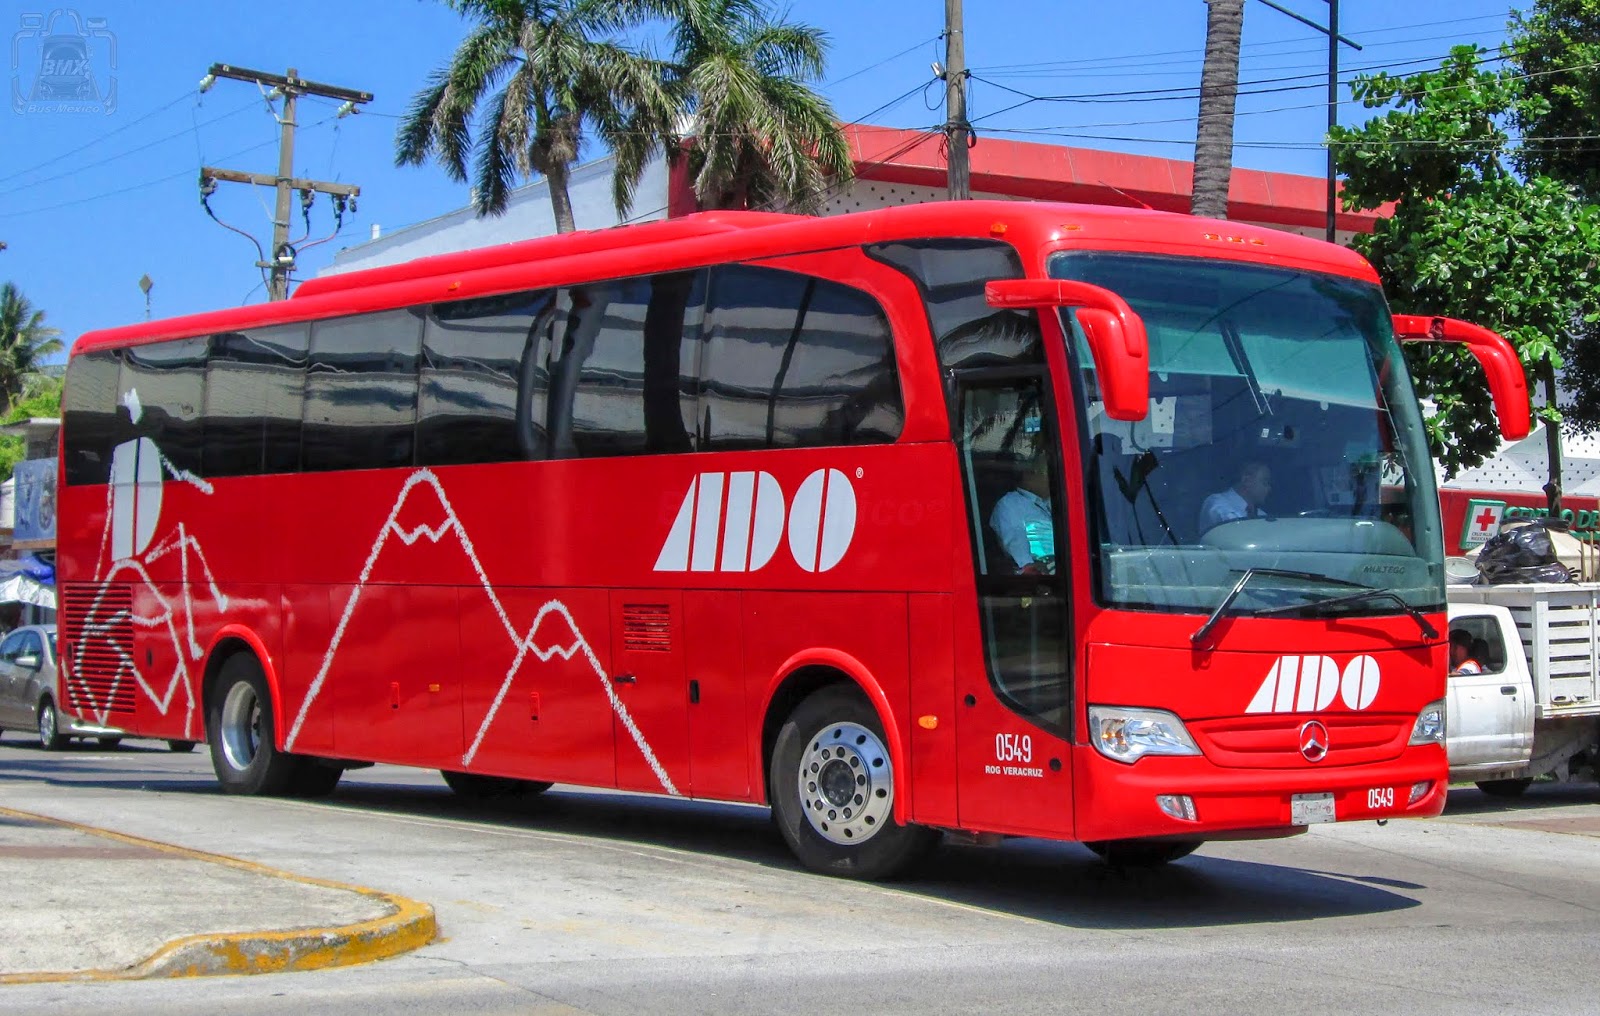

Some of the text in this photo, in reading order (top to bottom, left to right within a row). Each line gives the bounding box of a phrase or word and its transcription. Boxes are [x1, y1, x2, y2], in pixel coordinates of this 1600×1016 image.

[1244, 654, 1381, 713] ADO
[995, 733, 1032, 763] 0549
[985, 765, 1043, 777] ROG VERACRUZ
[1367, 787, 1394, 809] 0549
